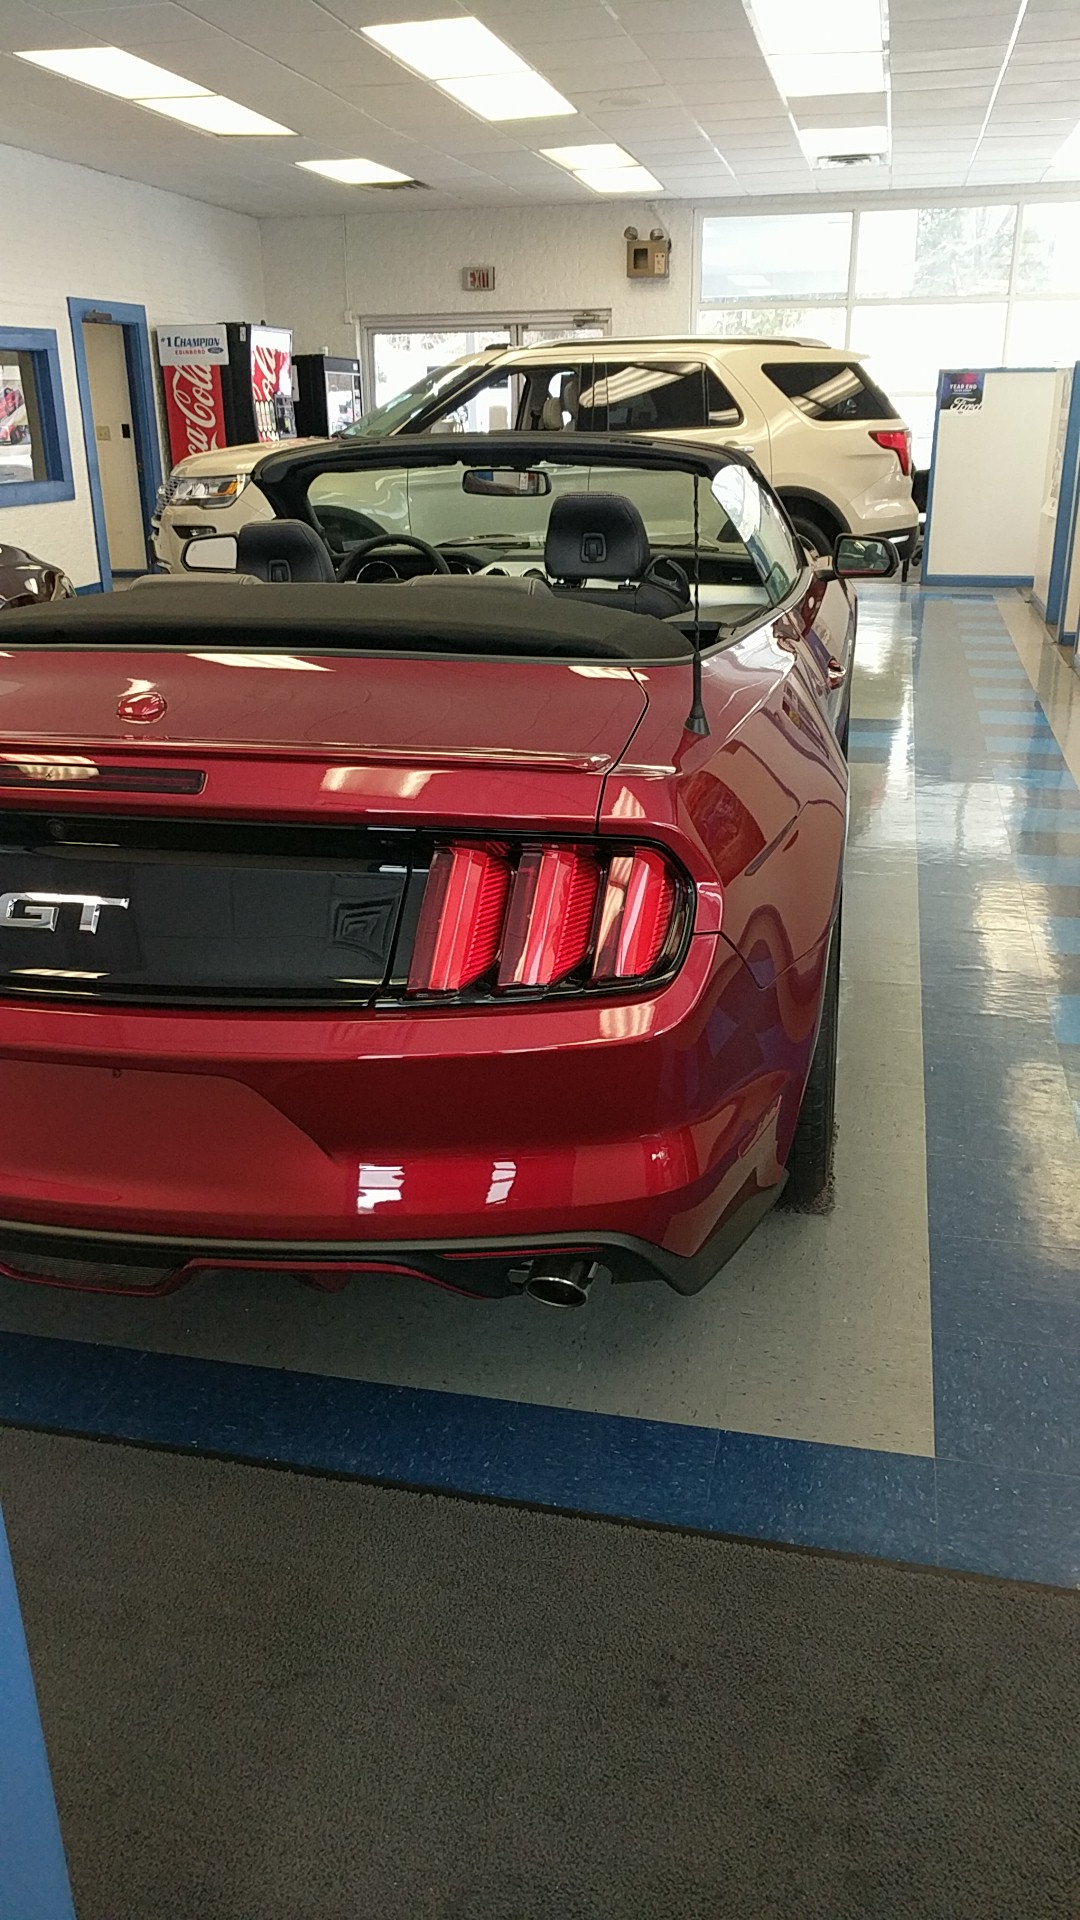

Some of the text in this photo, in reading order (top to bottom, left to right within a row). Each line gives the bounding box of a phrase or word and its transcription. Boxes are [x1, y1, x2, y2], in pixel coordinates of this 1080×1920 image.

[161, 336, 172, 347] #1
[950, 397, 983, 411] Ford
[0, 892, 130, 935] GT
